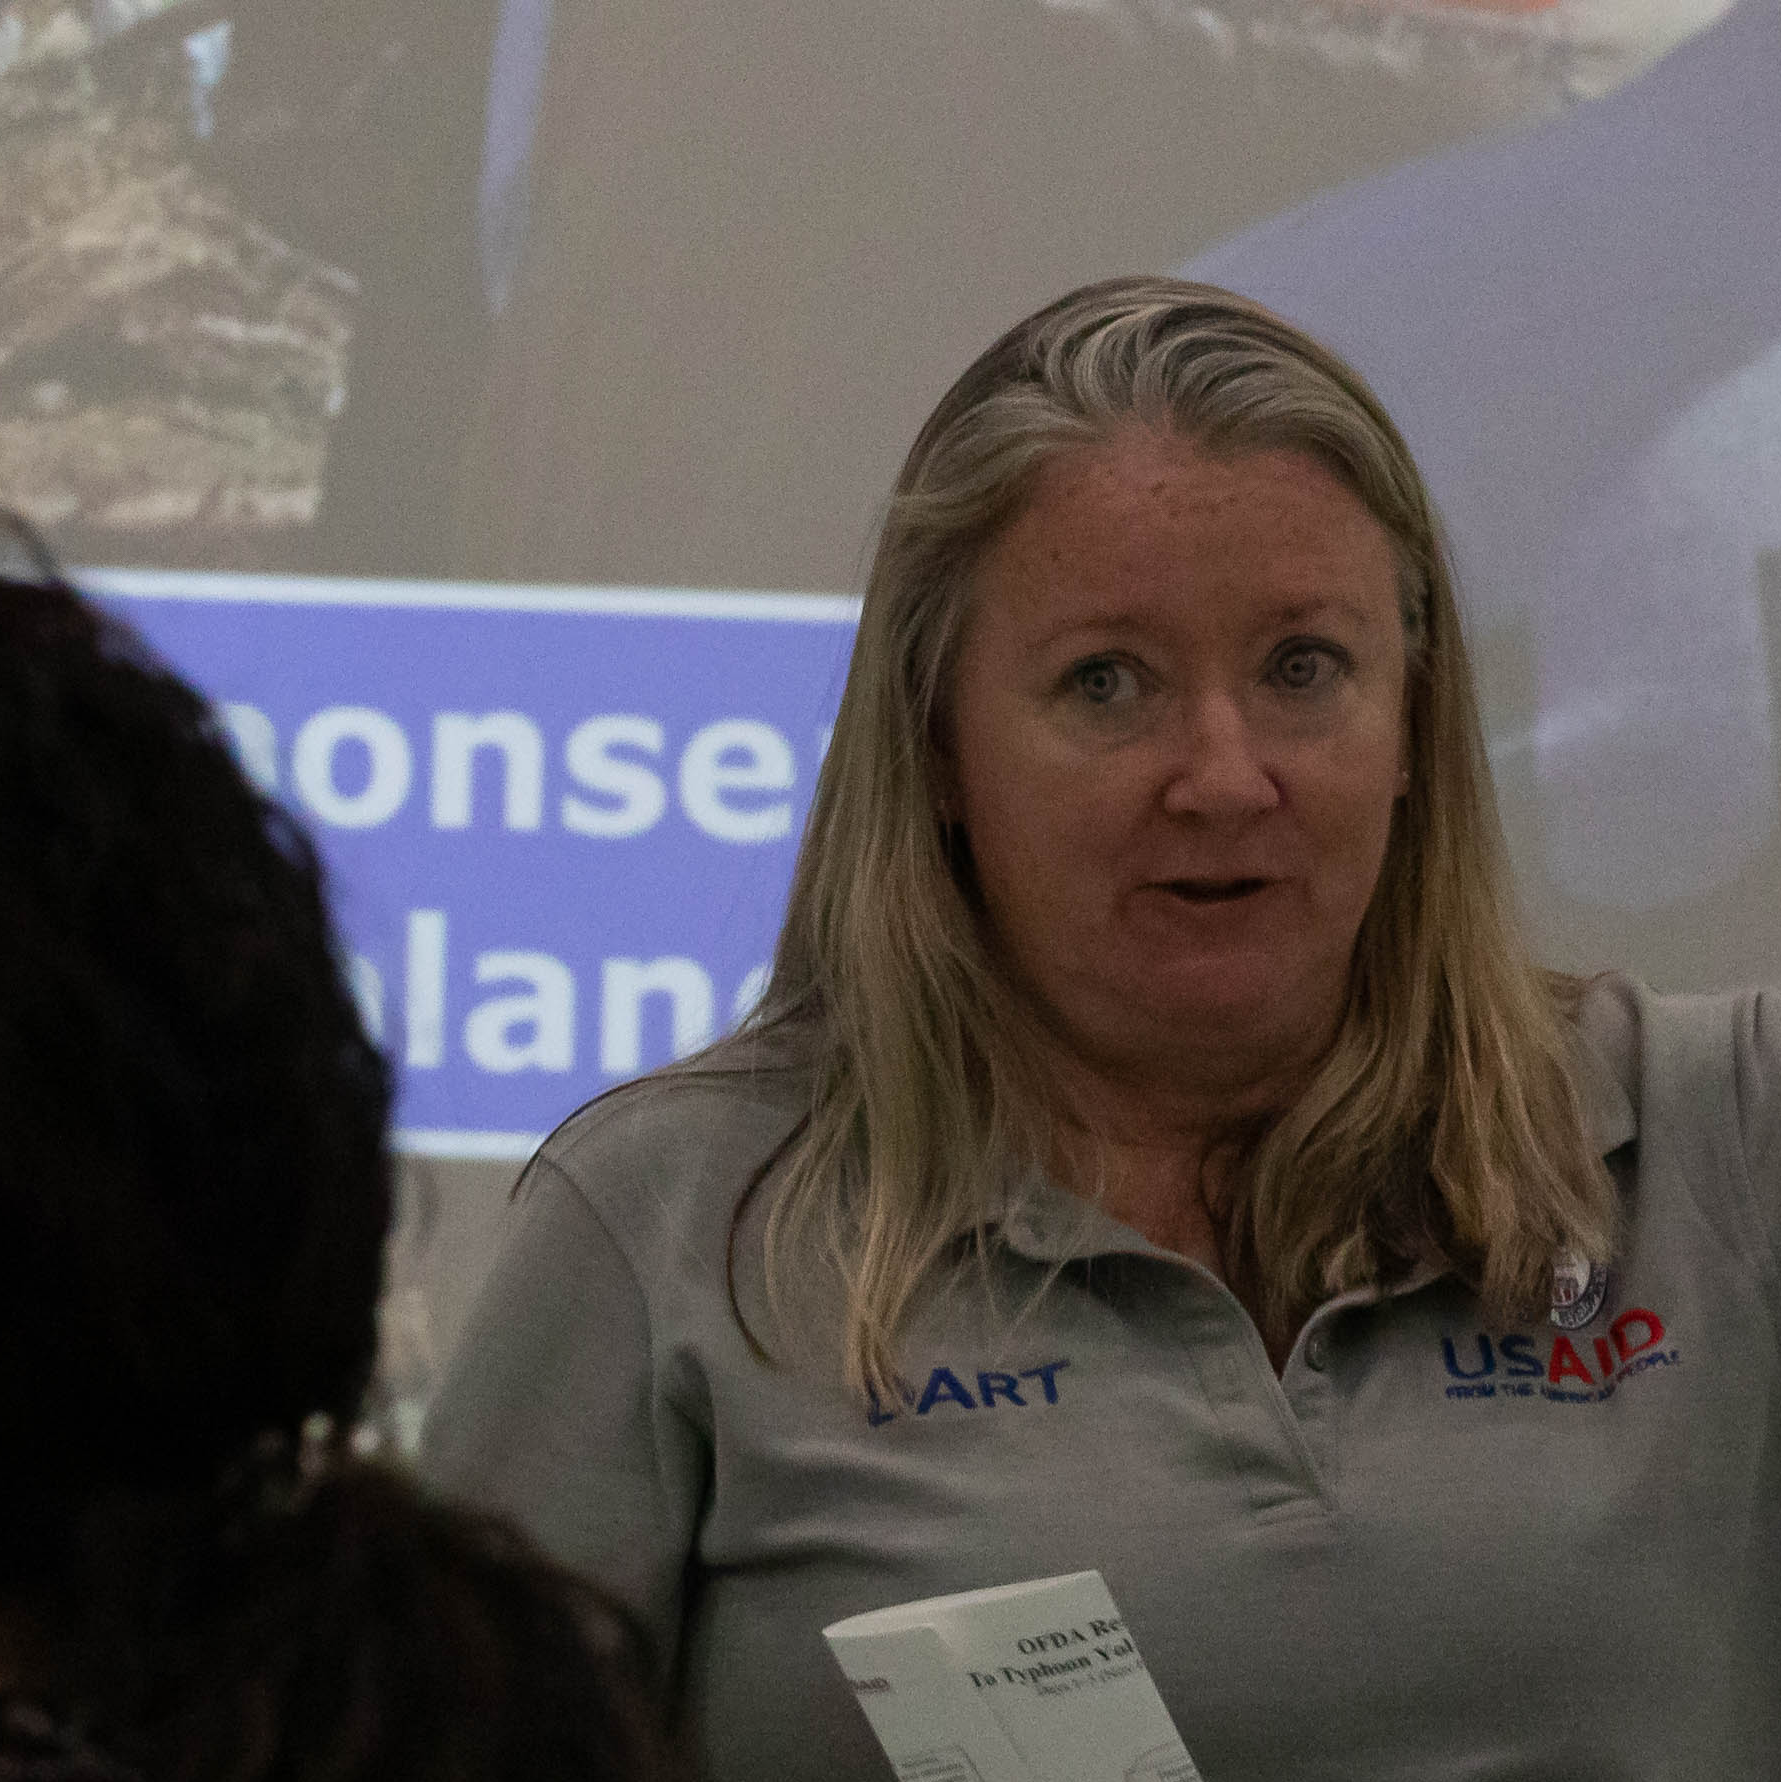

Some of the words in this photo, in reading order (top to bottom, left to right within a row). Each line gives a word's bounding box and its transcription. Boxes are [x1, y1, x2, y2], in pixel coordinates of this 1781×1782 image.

[1442, 1309, 1665, 1384] USAID
[1017, 1629, 1088, 1656] OFDA
[1001, 1656, 1092, 1687] Typhoon
